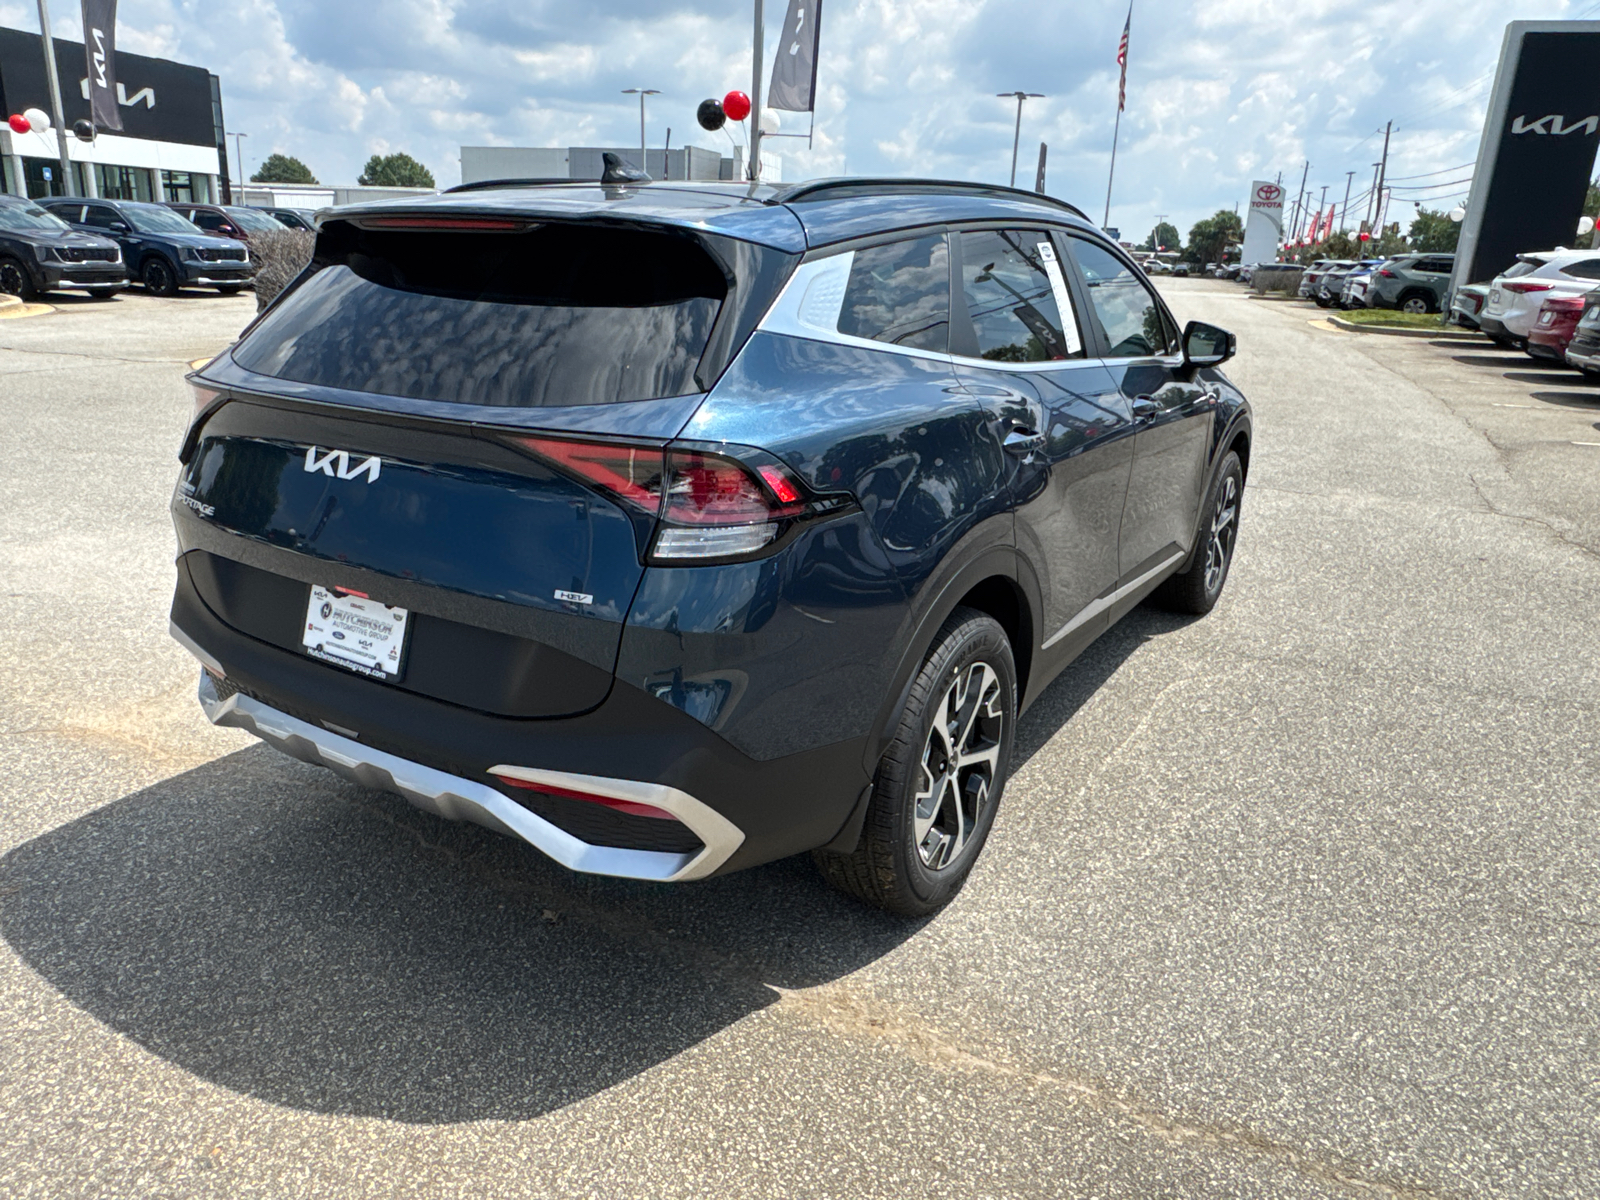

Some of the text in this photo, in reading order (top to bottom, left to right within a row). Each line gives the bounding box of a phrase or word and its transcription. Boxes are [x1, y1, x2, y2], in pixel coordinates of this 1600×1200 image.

[92, 27, 107, 88] KIA
[1511, 114, 1599, 136] KIA
[1251, 201, 1283, 209] TOYOTA
[304, 446, 381, 484] KIA
[561, 592, 588, 602] HEV
[332, 620, 368, 636] AUTOMOTIVE
[368, 630, 389, 642] GROUP
[333, 608, 394, 635] HUTCHINSON
